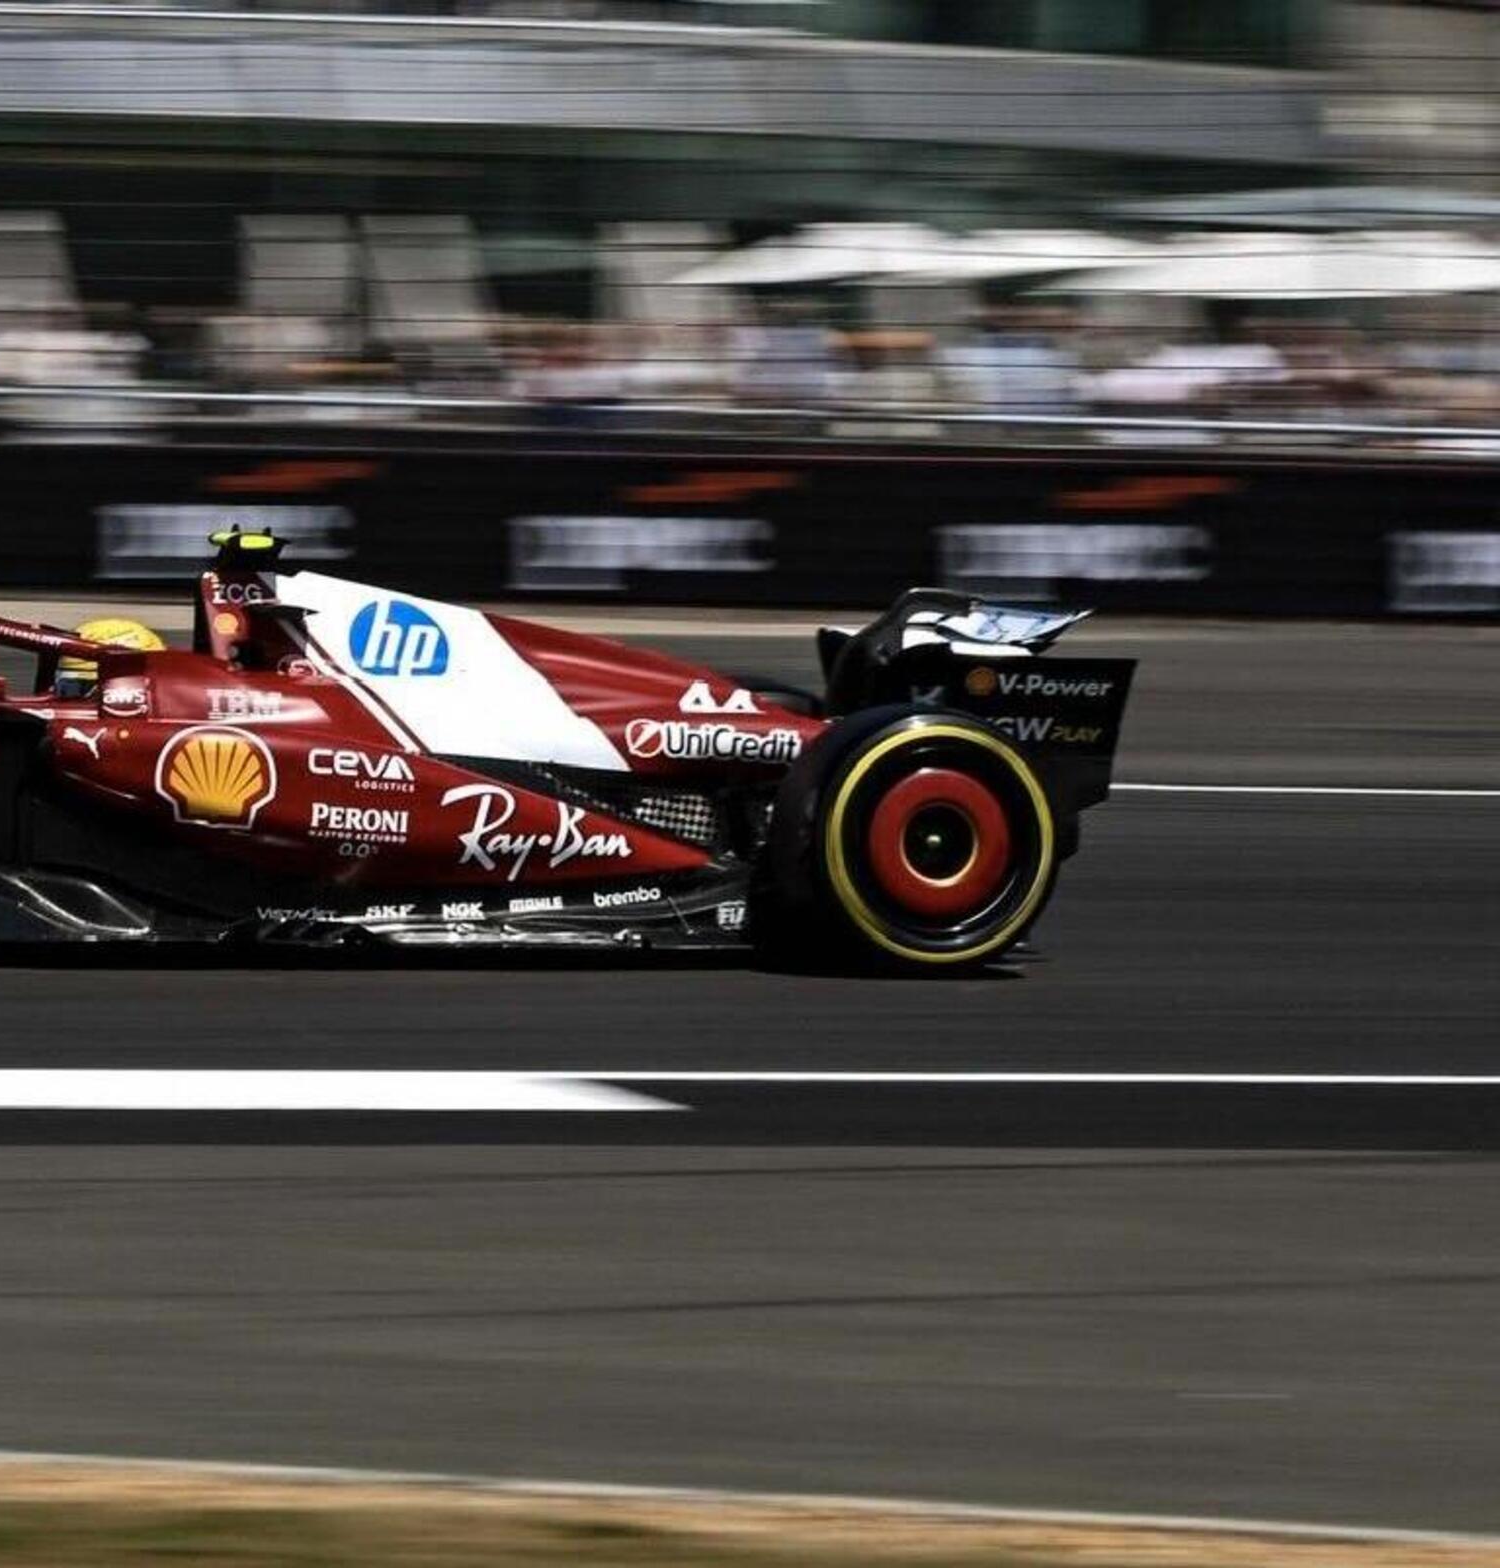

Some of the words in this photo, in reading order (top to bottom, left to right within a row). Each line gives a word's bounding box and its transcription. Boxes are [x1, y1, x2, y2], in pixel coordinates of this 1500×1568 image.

[360, 600, 440, 677] hp
[102, 687, 146, 704] aws
[999, 673, 1112, 697] V-Power
[205, 688, 282, 719] IBM
[664, 723, 799, 763] UniCredit
[355, 780, 415, 794] LOGISTICS
[310, 802, 409, 834] PERONI
[592, 886, 661, 908] brembo
[441, 902, 487, 921] NGK
